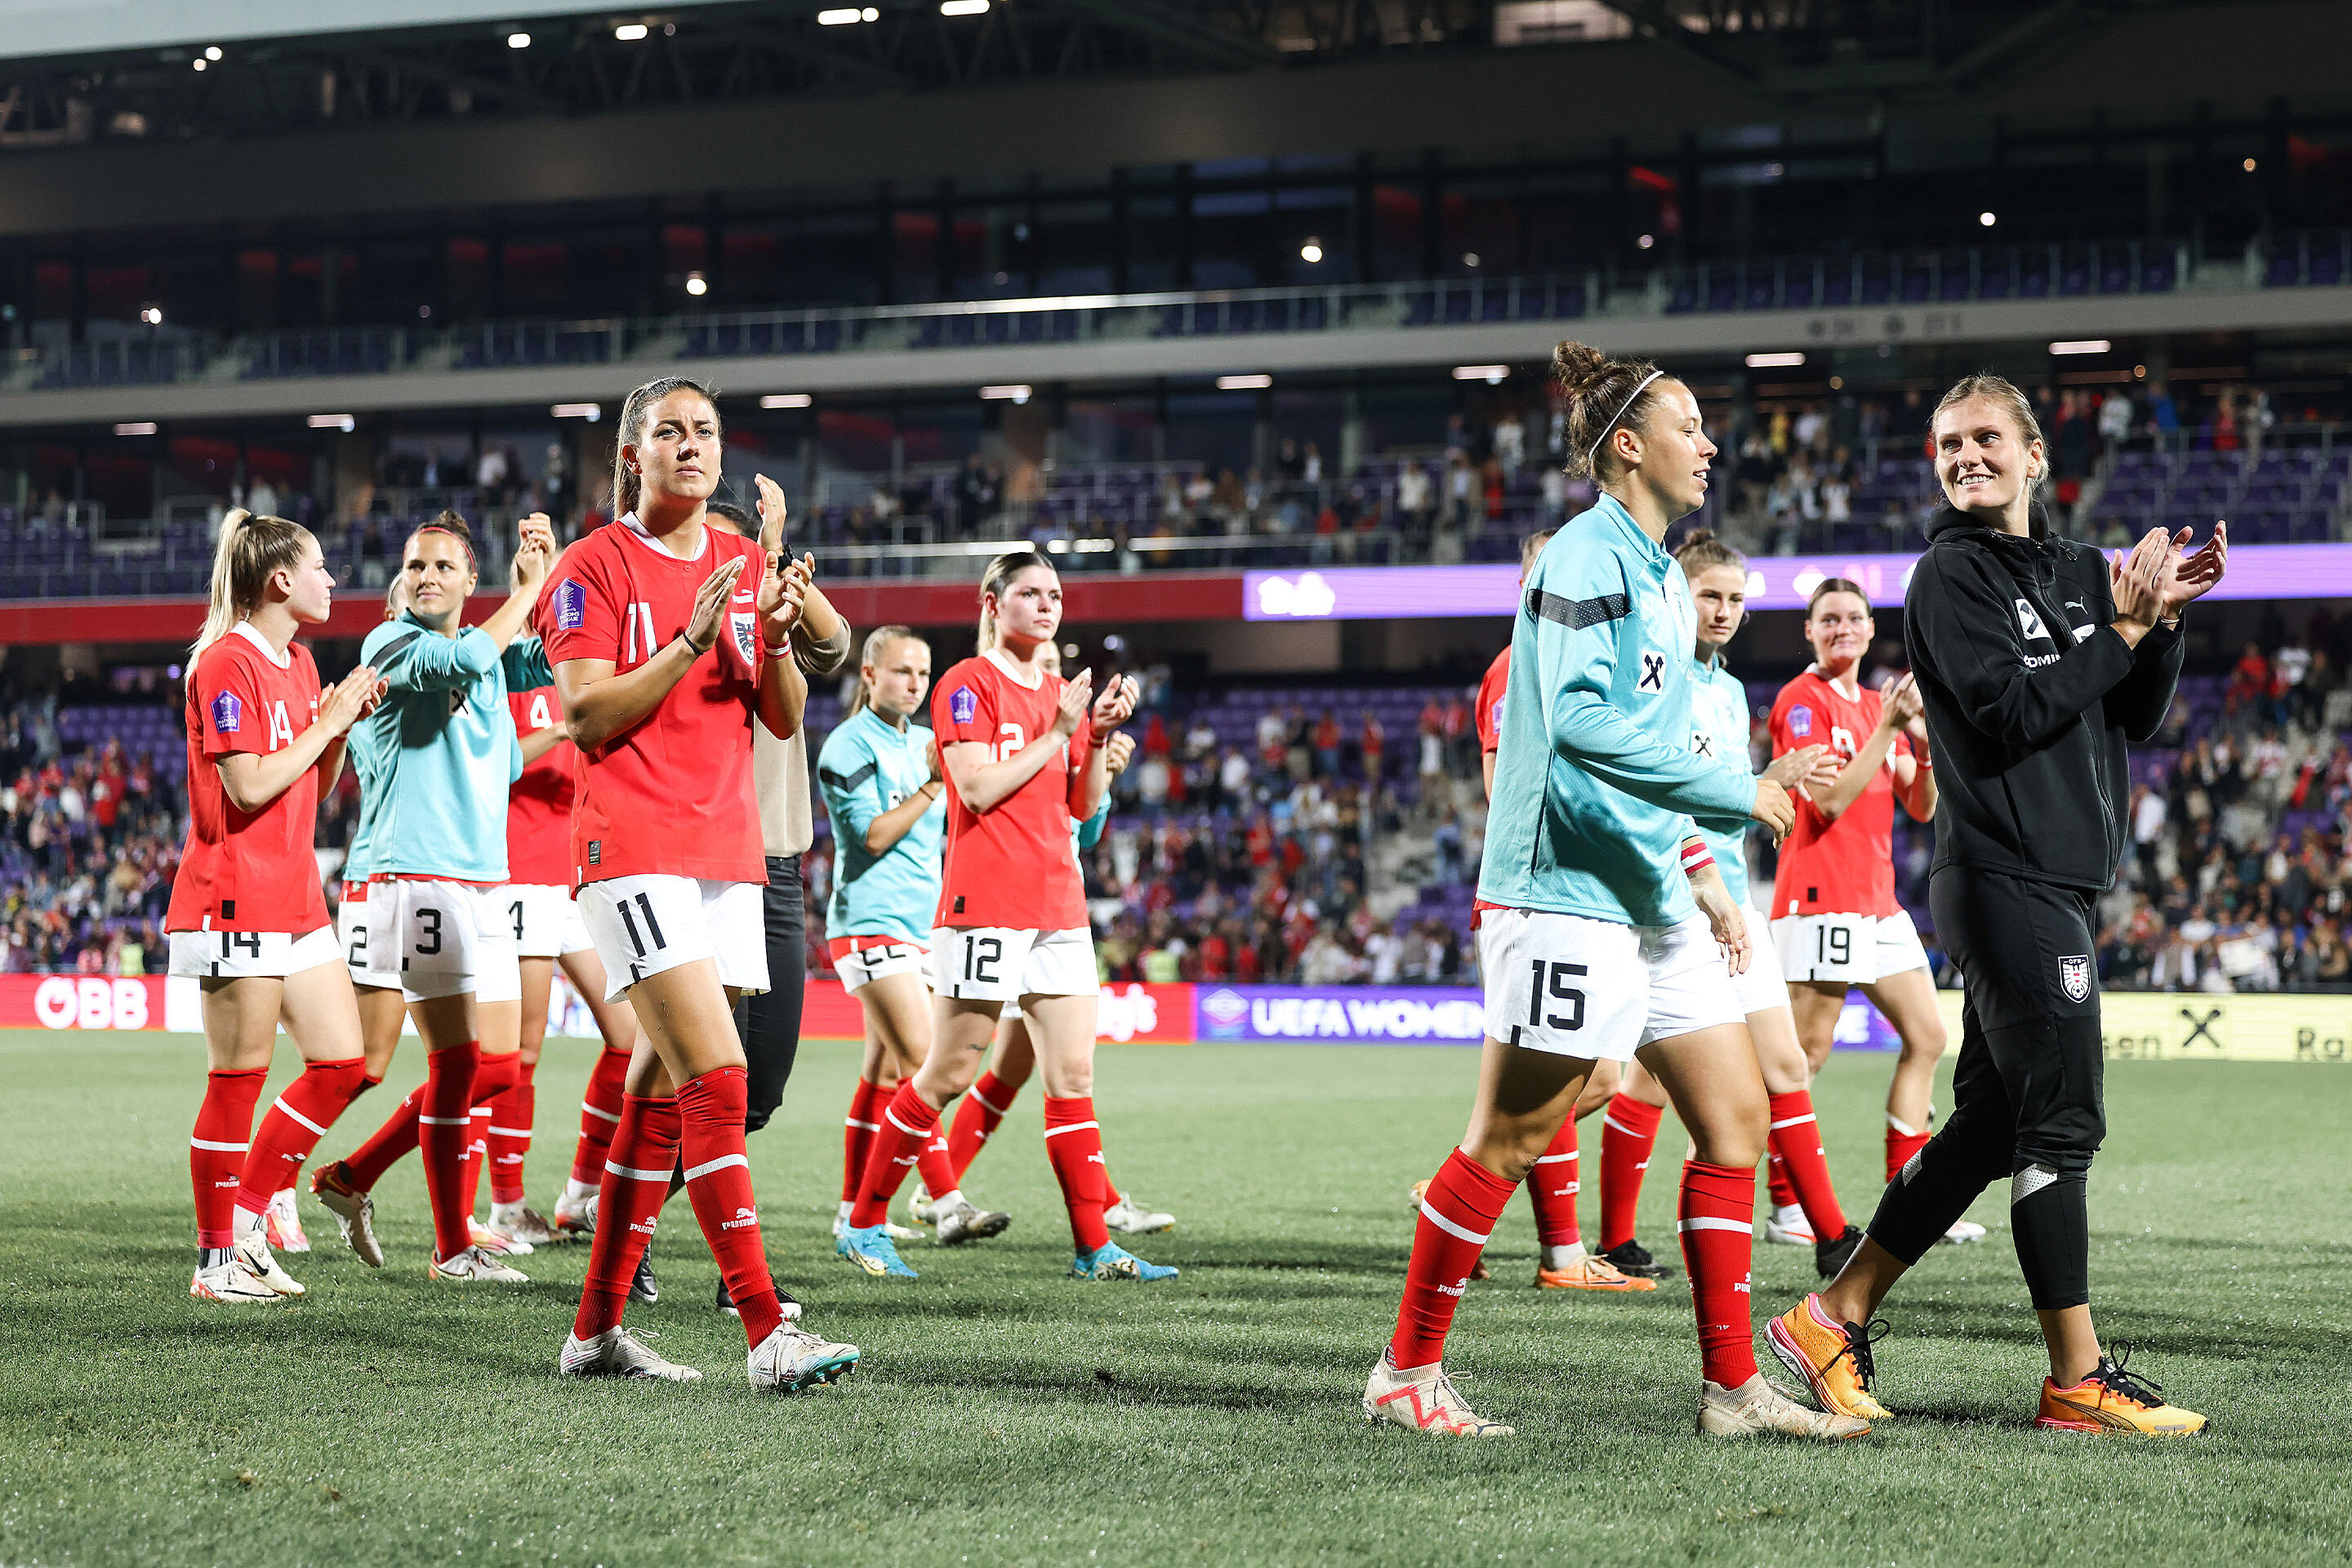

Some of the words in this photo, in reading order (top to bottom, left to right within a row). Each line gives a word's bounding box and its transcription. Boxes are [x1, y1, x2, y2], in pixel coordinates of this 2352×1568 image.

[628, 601, 657, 663] 11
[265, 700, 294, 751] 14
[530, 694, 553, 729] 4
[416, 908, 441, 955] 3
[617, 892, 666, 957] 11
[1818, 924, 1850, 964] 19
[965, 936, 1001, 982] 12
[1251, 997, 1349, 1037] UEFA
[1530, 960, 1588, 1031] 15
